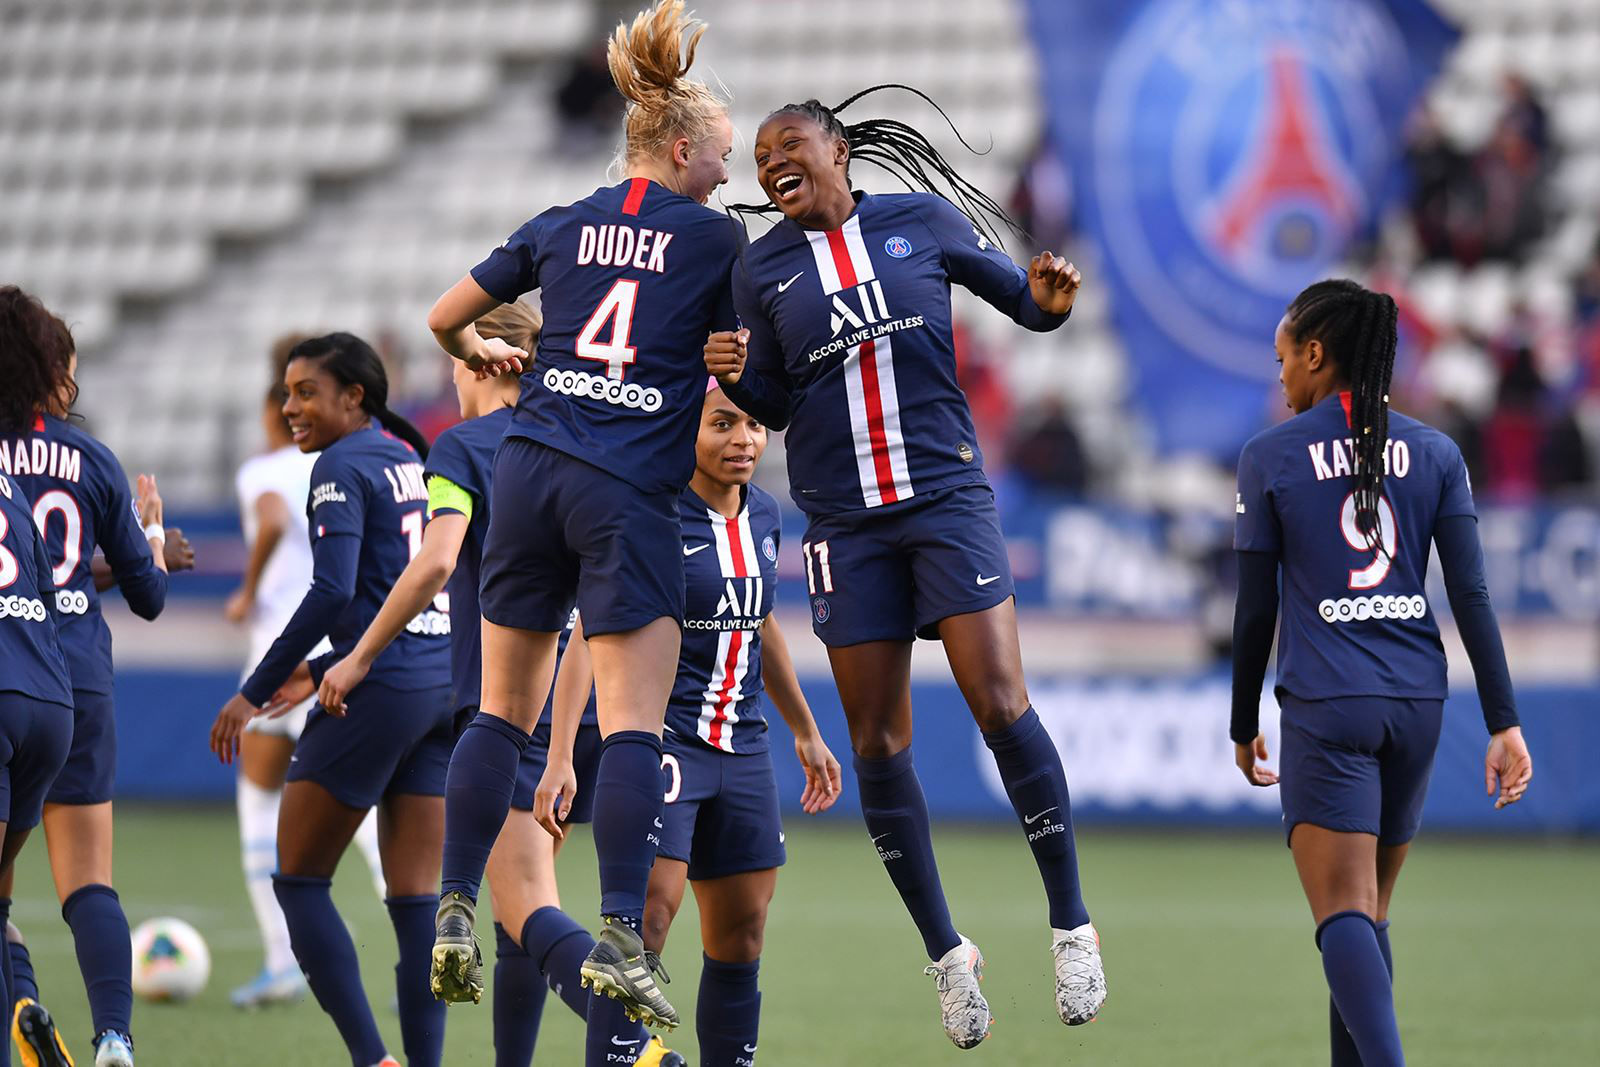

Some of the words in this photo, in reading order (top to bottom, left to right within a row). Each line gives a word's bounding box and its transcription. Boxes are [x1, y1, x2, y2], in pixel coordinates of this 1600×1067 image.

[577, 225, 673, 272] DUDEK
[576, 278, 640, 382] 4
[808, 339, 846, 363] ACCOR
[845, 329, 870, 346] LIVE
[872, 315, 924, 337] LIMITLESS
[544, 370, 661, 410] ooredoo
[0, 437, 81, 483] NADIM
[1308, 438, 1410, 480] KATTO
[1340, 488, 1397, 590] 9
[803, 540, 834, 595] 11
[683, 619, 721, 630] ACCOR
[722, 619, 742, 630] LIVE
[1028, 823, 1065, 842] PARIS
[607, 1053, 638, 1064] PARI
